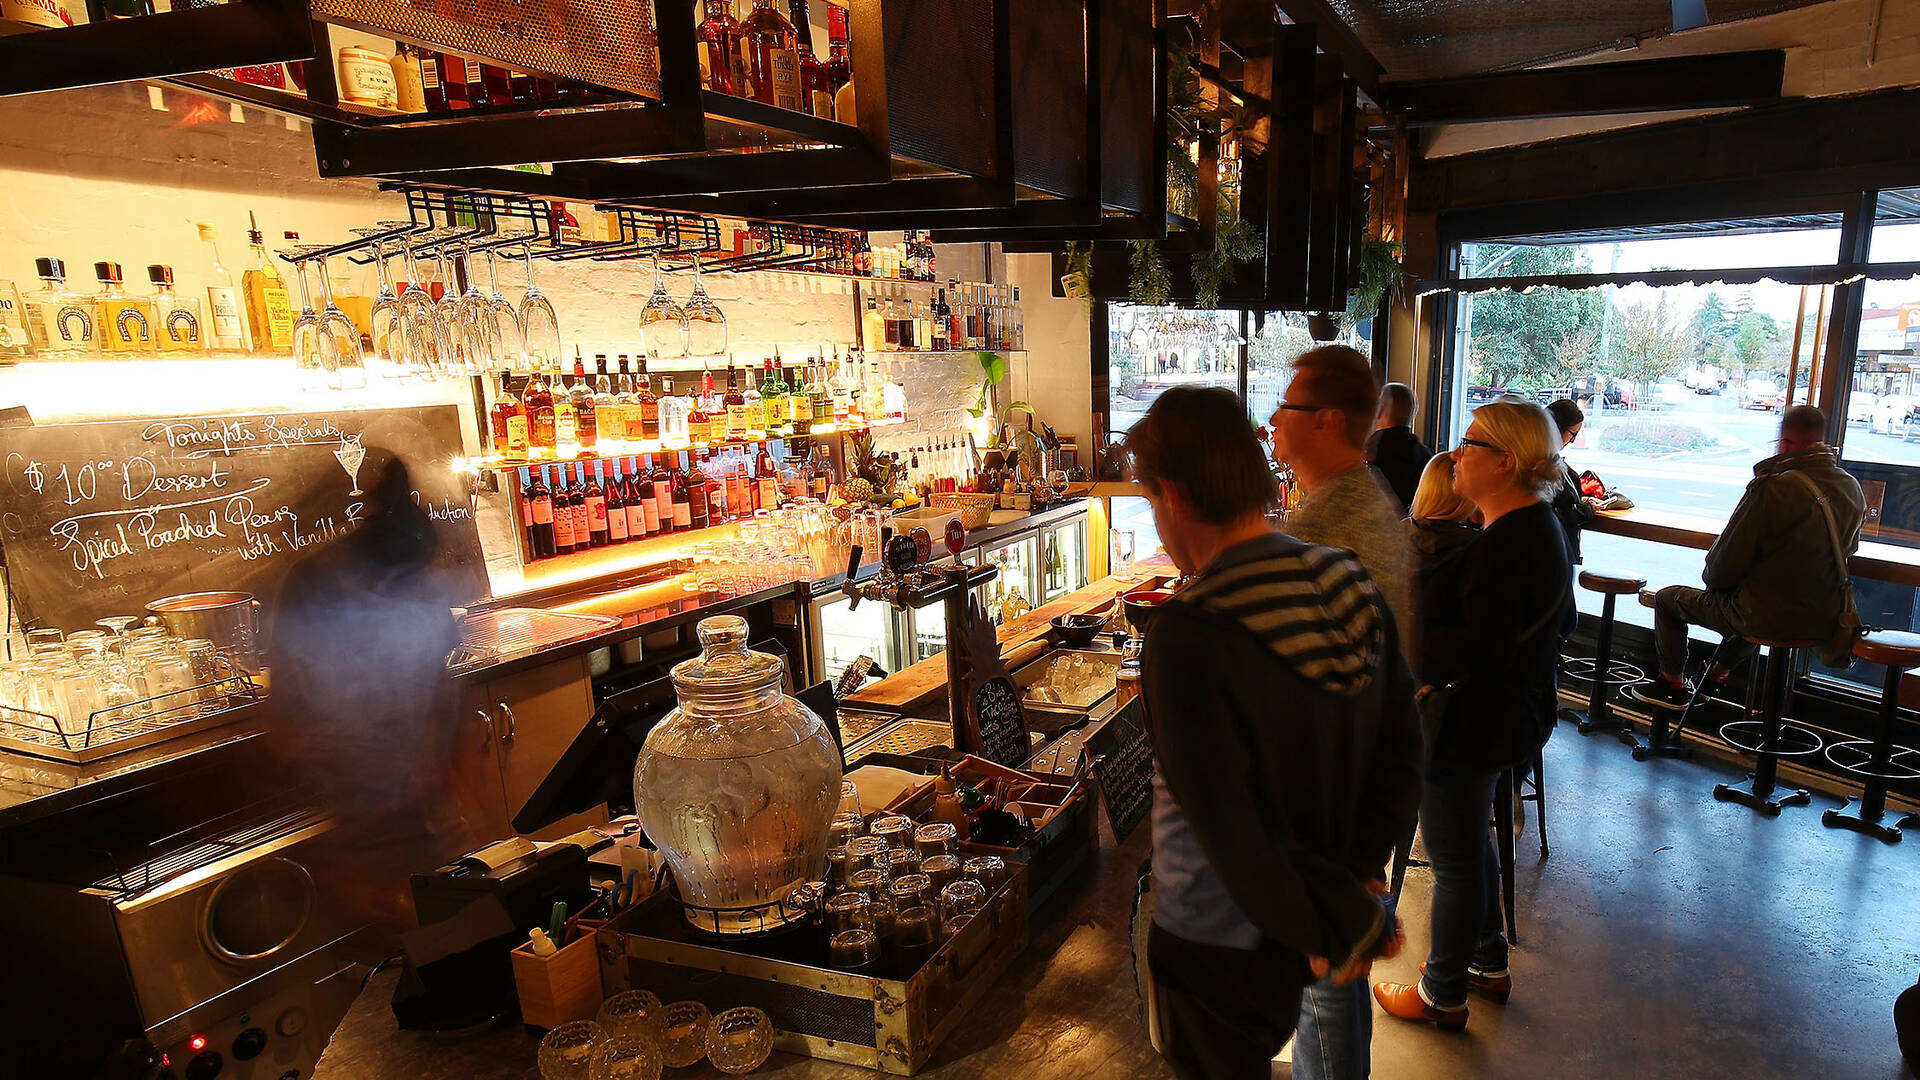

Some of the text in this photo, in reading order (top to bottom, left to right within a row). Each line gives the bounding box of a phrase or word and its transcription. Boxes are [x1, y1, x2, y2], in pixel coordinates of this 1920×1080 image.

[778, 72, 792, 81] RYE
[142, 415, 341, 456] Tonights Specials
[122, 456, 230, 501] Dessert
[50, 520, 133, 579] Spiced
[127, 509, 228, 550] Poached
[224, 495, 298, 544] Pears
[238, 531, 282, 562] with
